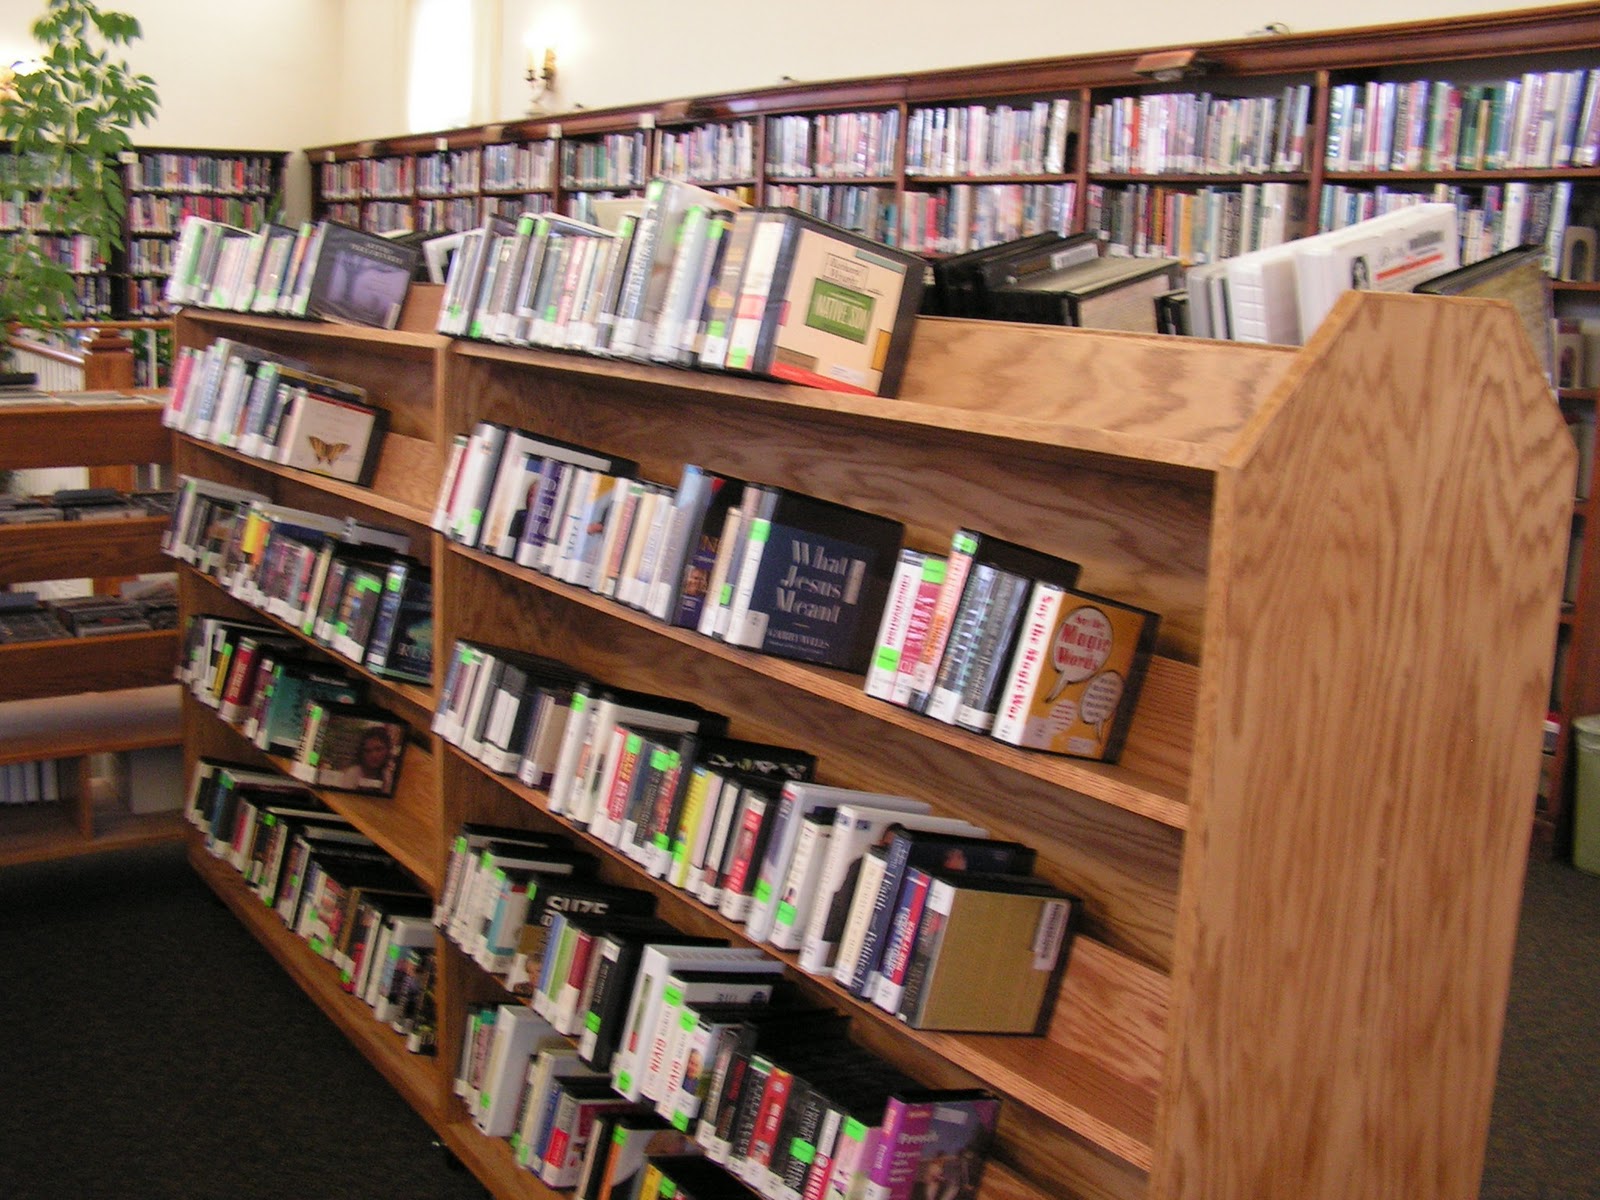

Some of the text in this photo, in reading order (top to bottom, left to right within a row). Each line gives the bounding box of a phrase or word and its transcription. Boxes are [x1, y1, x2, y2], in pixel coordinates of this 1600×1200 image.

[792, 540, 848, 576] What
[781, 565, 841, 598] Jesus
[777, 587, 840, 623] Meant
[1033, 593, 1054, 621] Say
[1027, 622, 1047, 646] the
[1012, 646, 1038, 692] Magic
